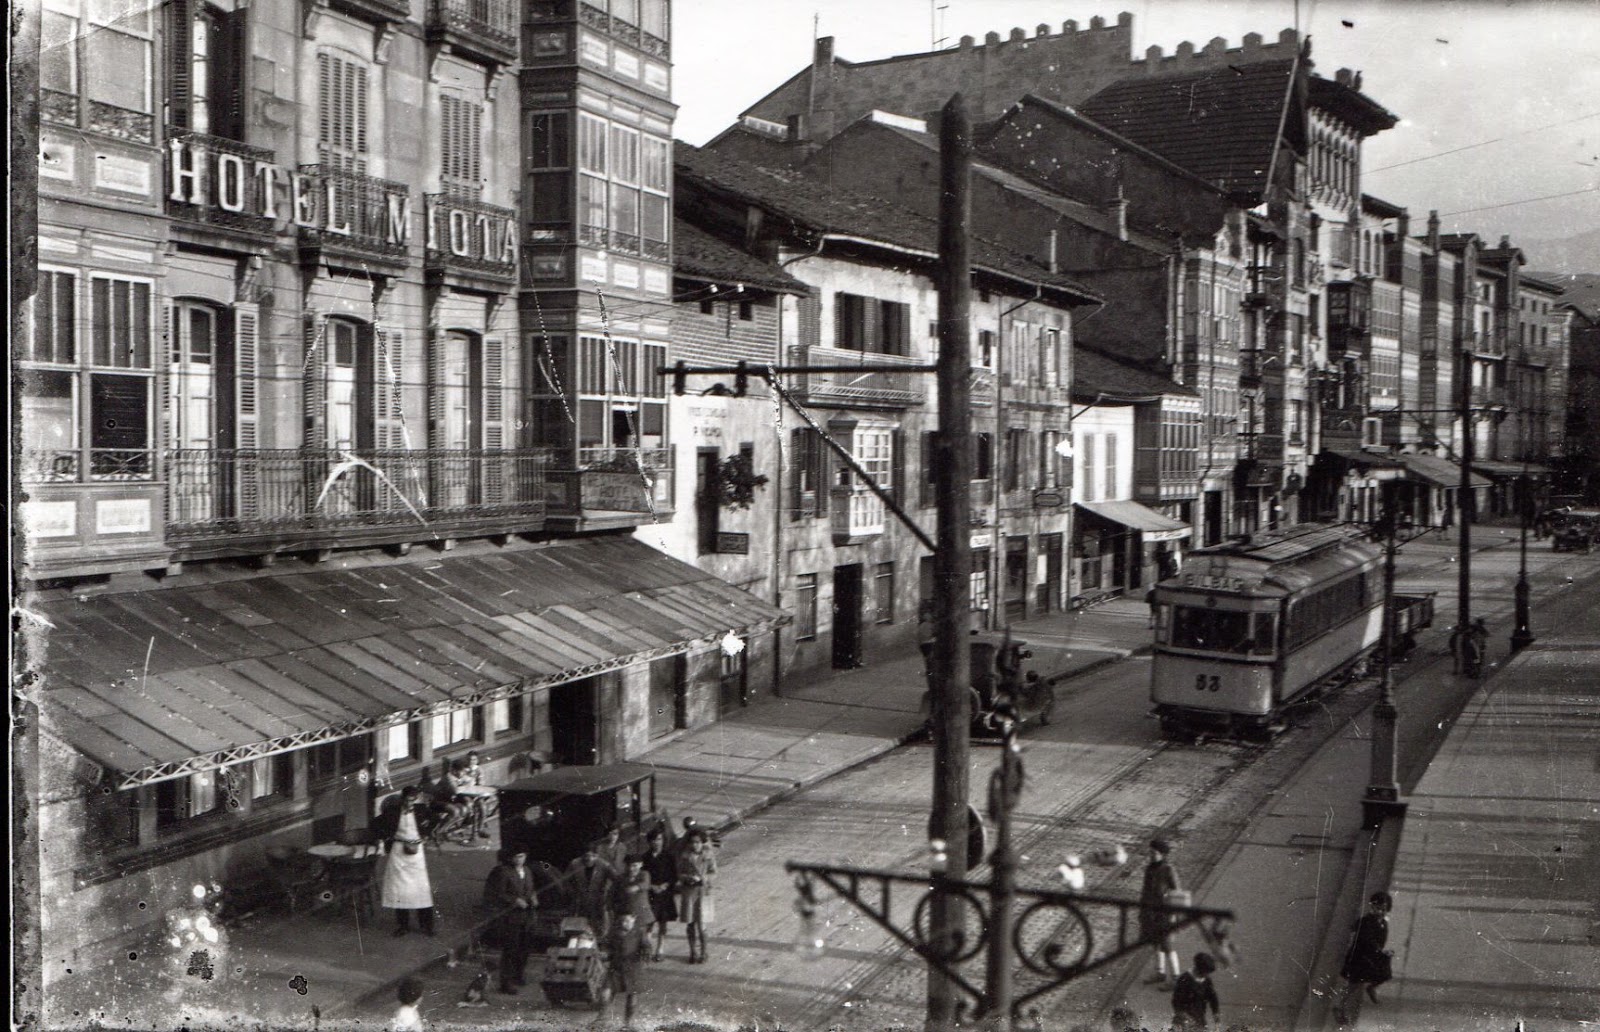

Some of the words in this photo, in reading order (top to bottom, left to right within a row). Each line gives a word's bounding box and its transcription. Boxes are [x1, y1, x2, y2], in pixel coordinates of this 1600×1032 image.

[169, 138, 350, 235] HOTEL
[388, 195, 519, 264] MIOTA
[1195, 673, 1222, 693] 53
